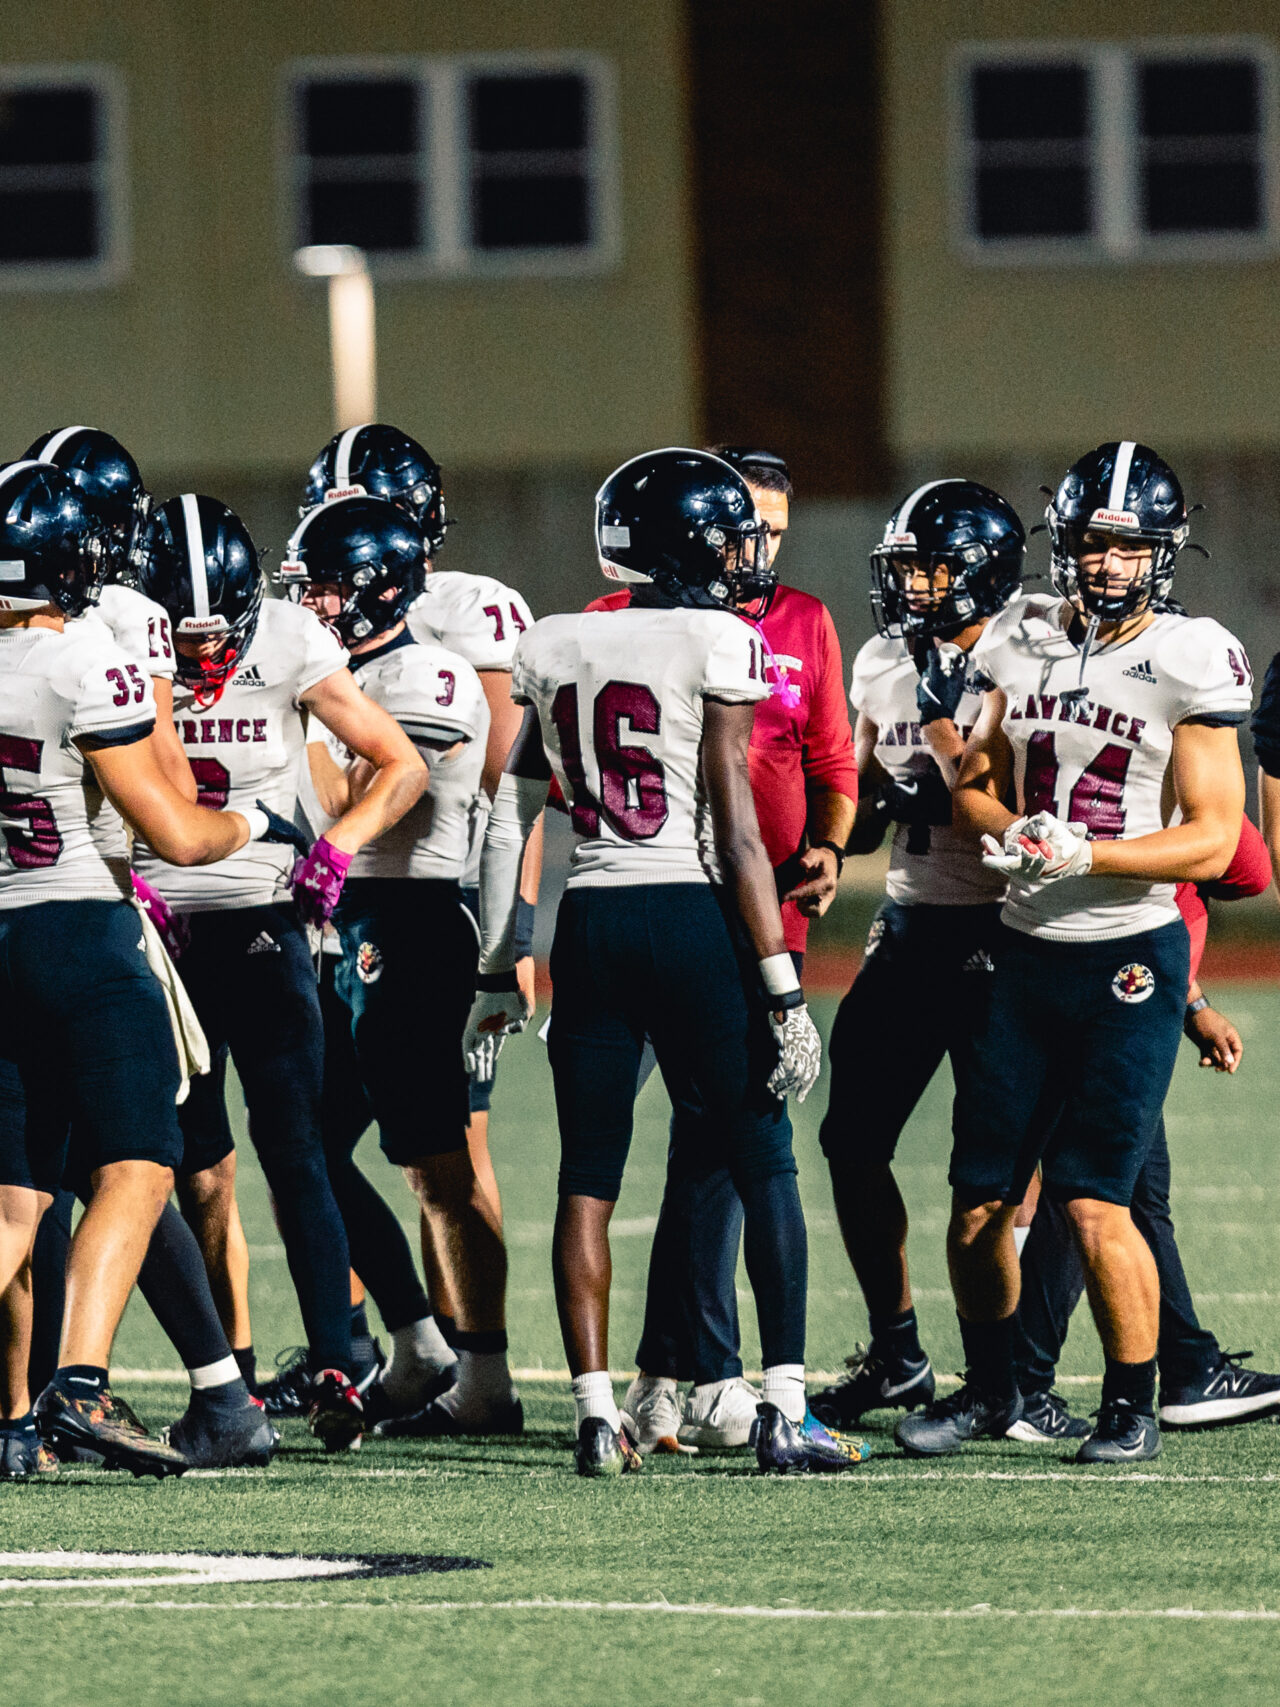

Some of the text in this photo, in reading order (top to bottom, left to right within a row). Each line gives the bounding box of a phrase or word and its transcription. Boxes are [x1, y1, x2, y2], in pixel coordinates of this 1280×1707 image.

[185, 619, 221, 628] Riddell
[104, 663, 146, 707] 35
[231, 679, 267, 687] adidas
[435, 669, 456, 707] 3
[1122, 669, 1158, 684] adidas
[549, 679, 670, 842] 16
